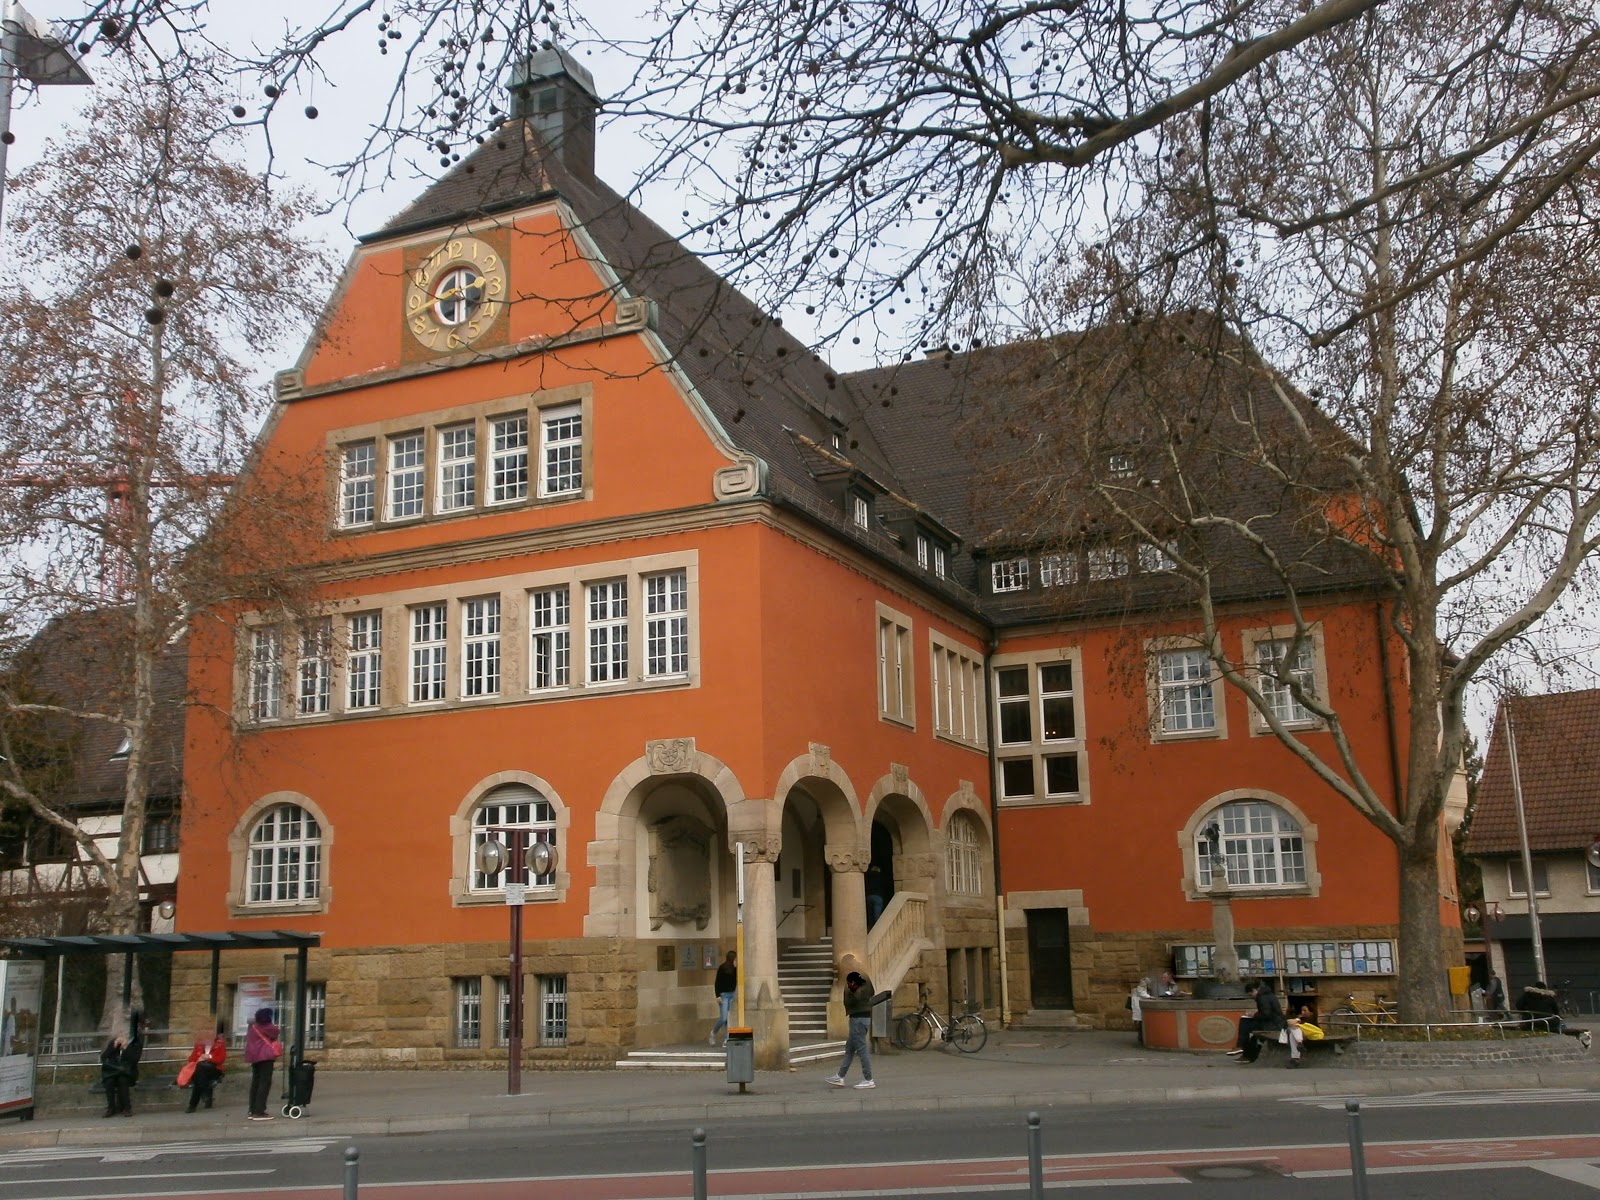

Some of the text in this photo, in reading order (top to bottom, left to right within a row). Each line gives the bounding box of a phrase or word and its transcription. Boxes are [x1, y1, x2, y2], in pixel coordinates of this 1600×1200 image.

[447, 241, 463, 259] 12
[471, 242, 478, 259] 1
[484, 254, 497, 273] 2
[488, 277, 502, 296] 3
[482, 301, 496, 318] 4
[413, 316, 426, 335] 8
[467, 319, 481, 339] 5
[428, 328, 440, 348] 7
[446, 327, 460, 349] 6
